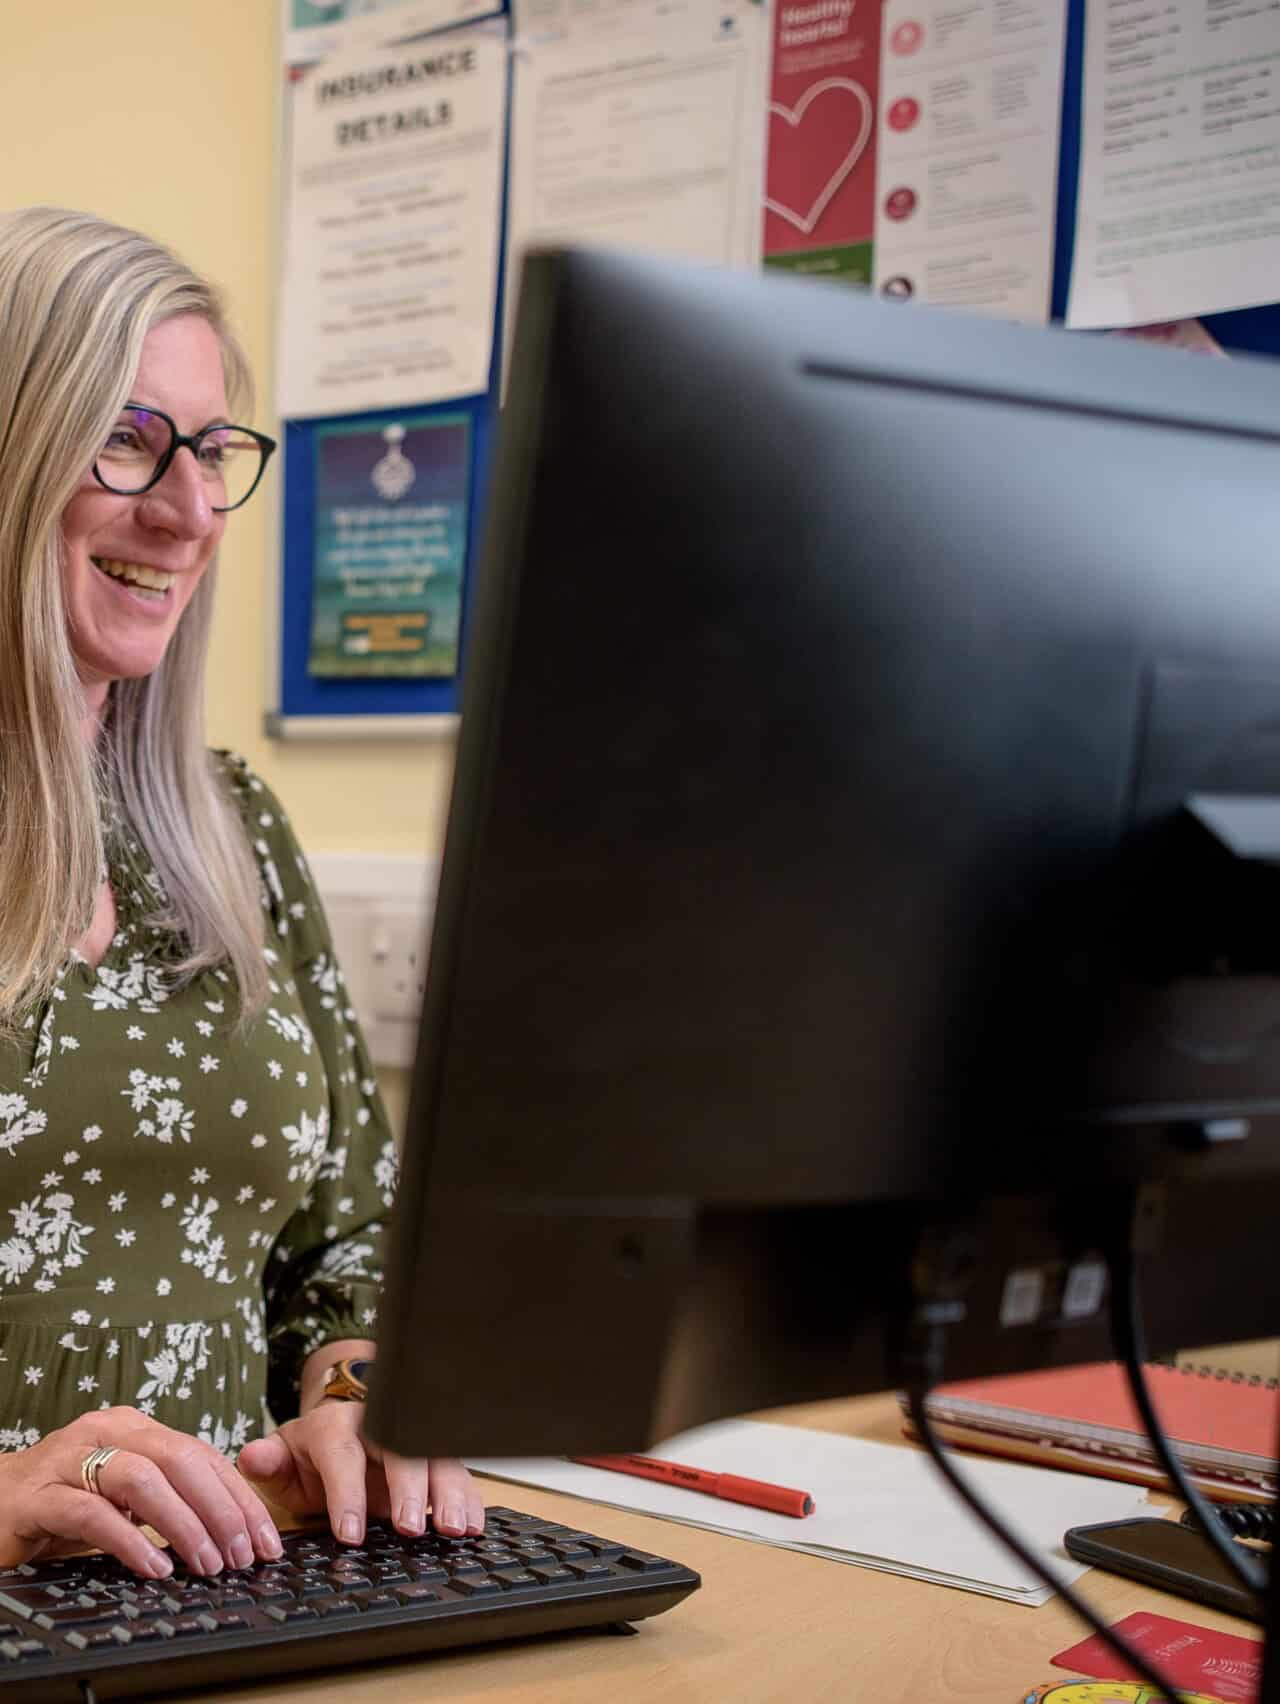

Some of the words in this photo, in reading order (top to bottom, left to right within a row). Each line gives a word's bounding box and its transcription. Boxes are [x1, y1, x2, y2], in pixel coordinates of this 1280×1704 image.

[781, 0, 856, 27] Healthy
[318, 49, 476, 102] INSURANCE
[336, 99, 452, 144] DETAILS
